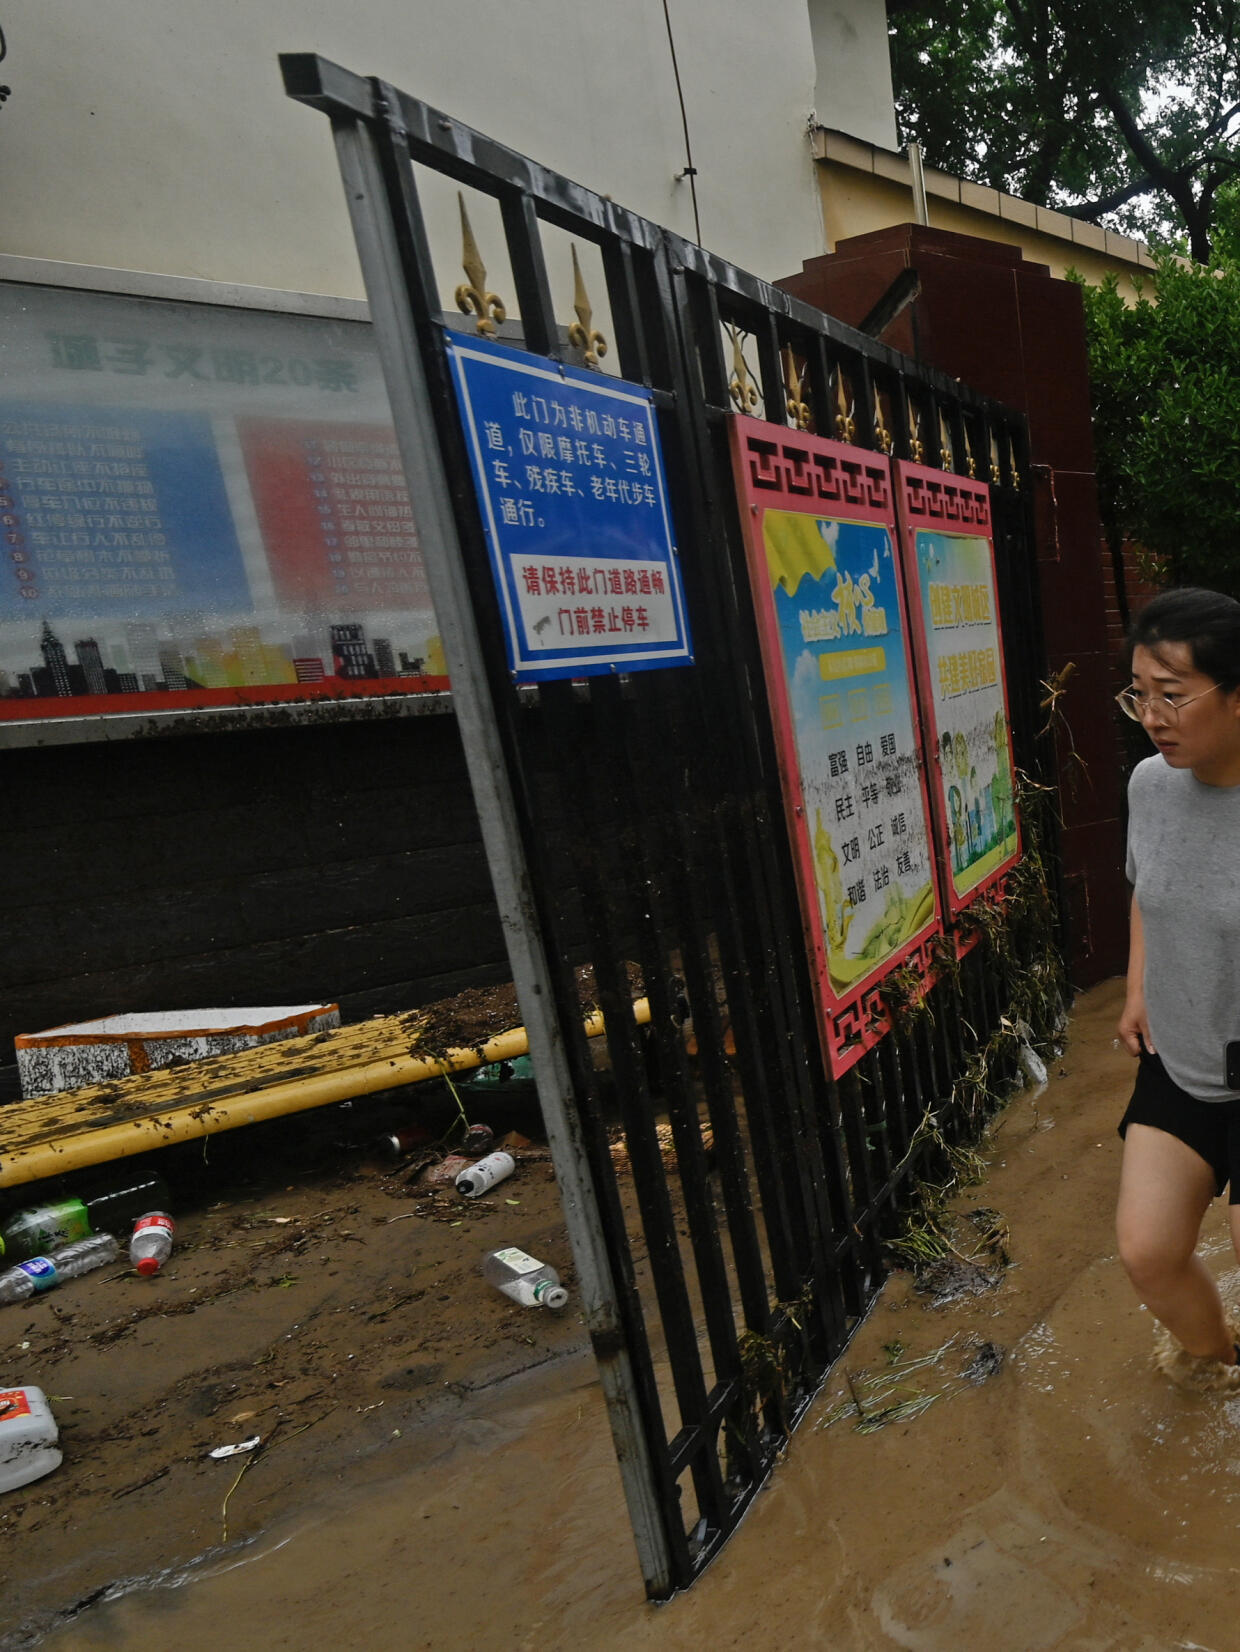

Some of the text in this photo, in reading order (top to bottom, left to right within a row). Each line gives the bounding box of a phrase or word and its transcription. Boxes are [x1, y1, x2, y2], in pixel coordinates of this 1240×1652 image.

[512, 391, 647, 446] 此门为非机动车通
[484, 420, 652, 478] 道，仅限摩托车、三轮
[492, 459, 656, 508] 车、残疾车、老年代步车
[500, 497, 545, 528] 通行。
[522, 565, 665, 596] 请保持此门道路通畅
[557, 607, 650, 635] 门前禁止停车
[828, 733, 897, 778] 富强 自由 爱国
[835, 795, 855, 823] 民主
[861, 782, 879, 809] 平等
[841, 812, 907, 866] 文明 公正 诚信
[847, 879, 867, 909] 和谐
[872, 864, 890, 891] 法治
